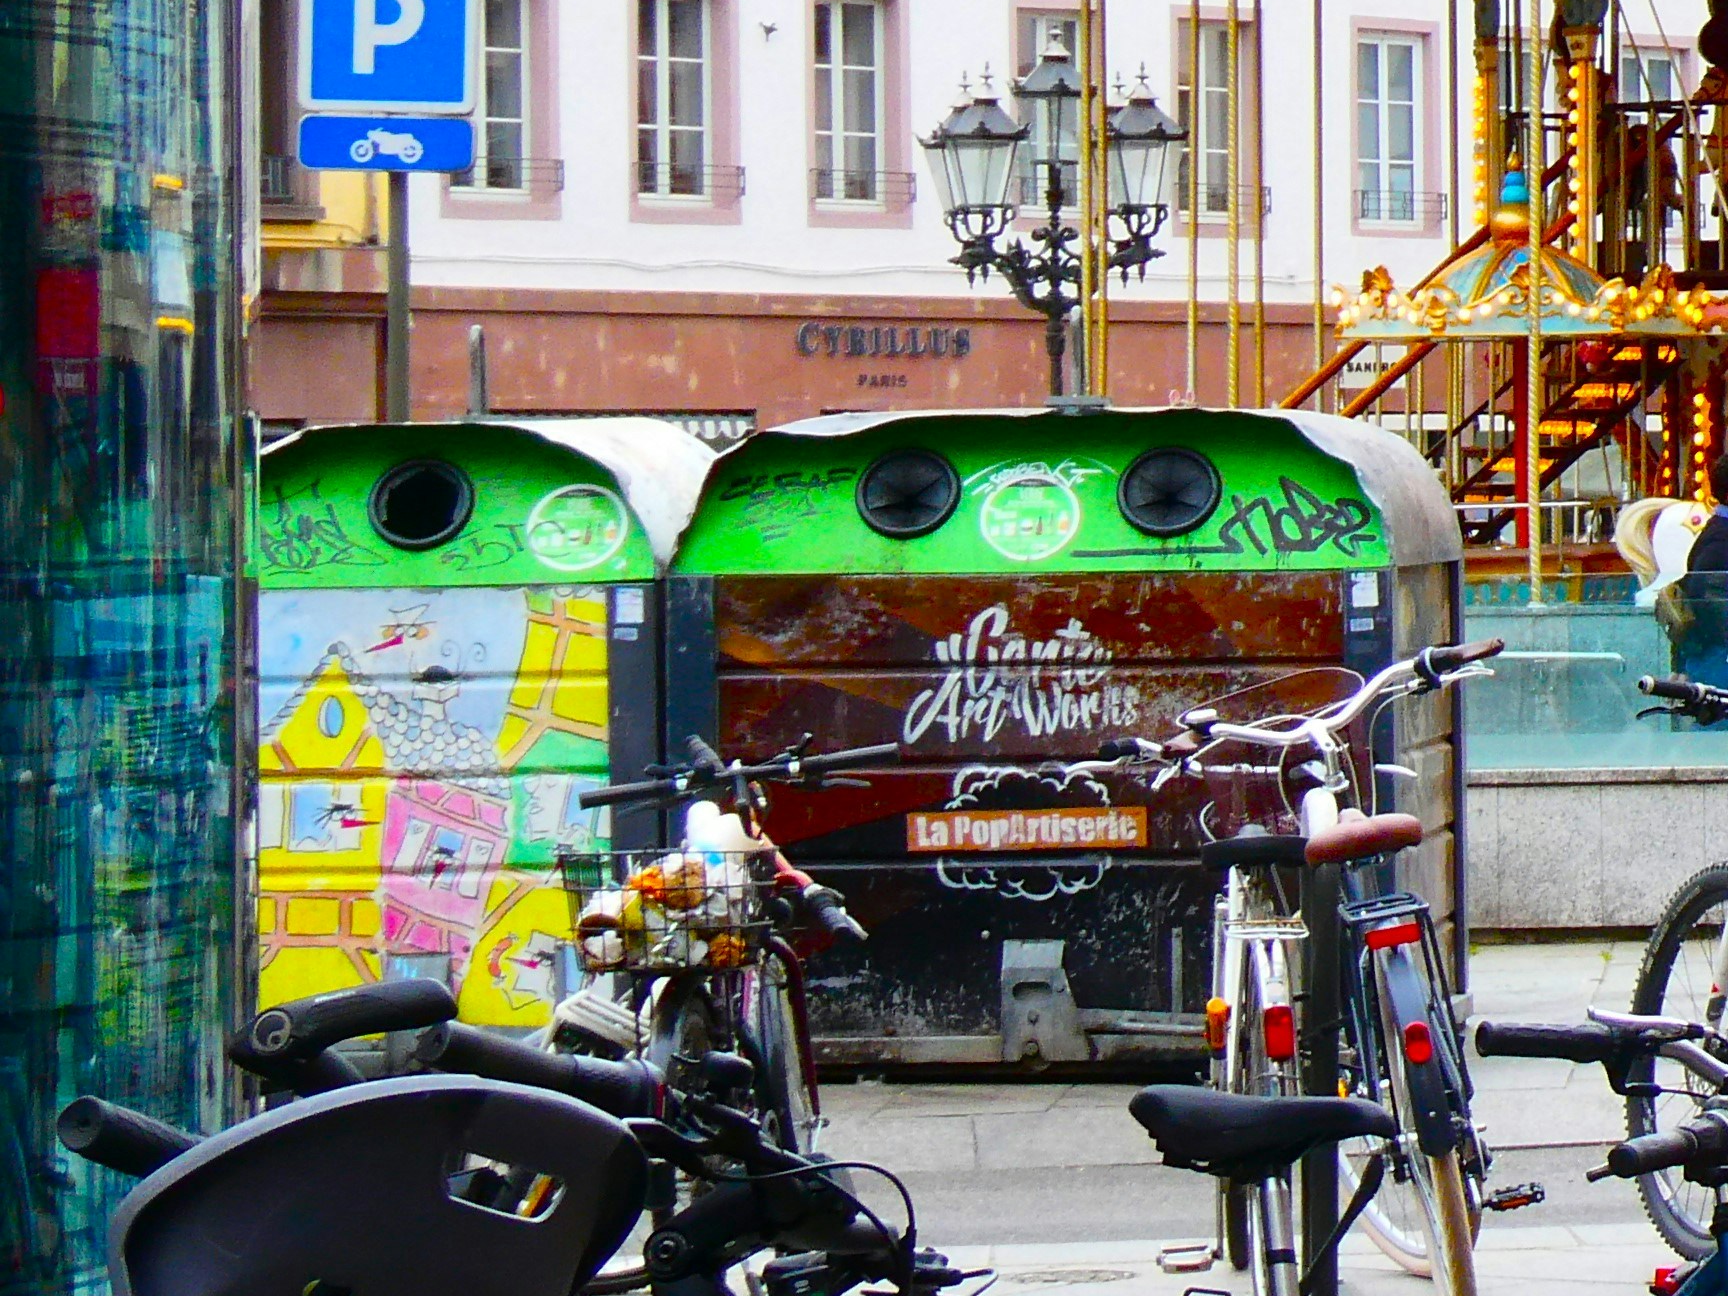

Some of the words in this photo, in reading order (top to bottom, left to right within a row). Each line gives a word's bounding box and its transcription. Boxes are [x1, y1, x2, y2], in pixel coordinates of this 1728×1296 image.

[796, 321, 971, 358] CYRILLUS
[856, 373, 909, 389] PARIS
[916, 814, 949, 848] La
[952, 809, 1139, 849] PopArtiserie
